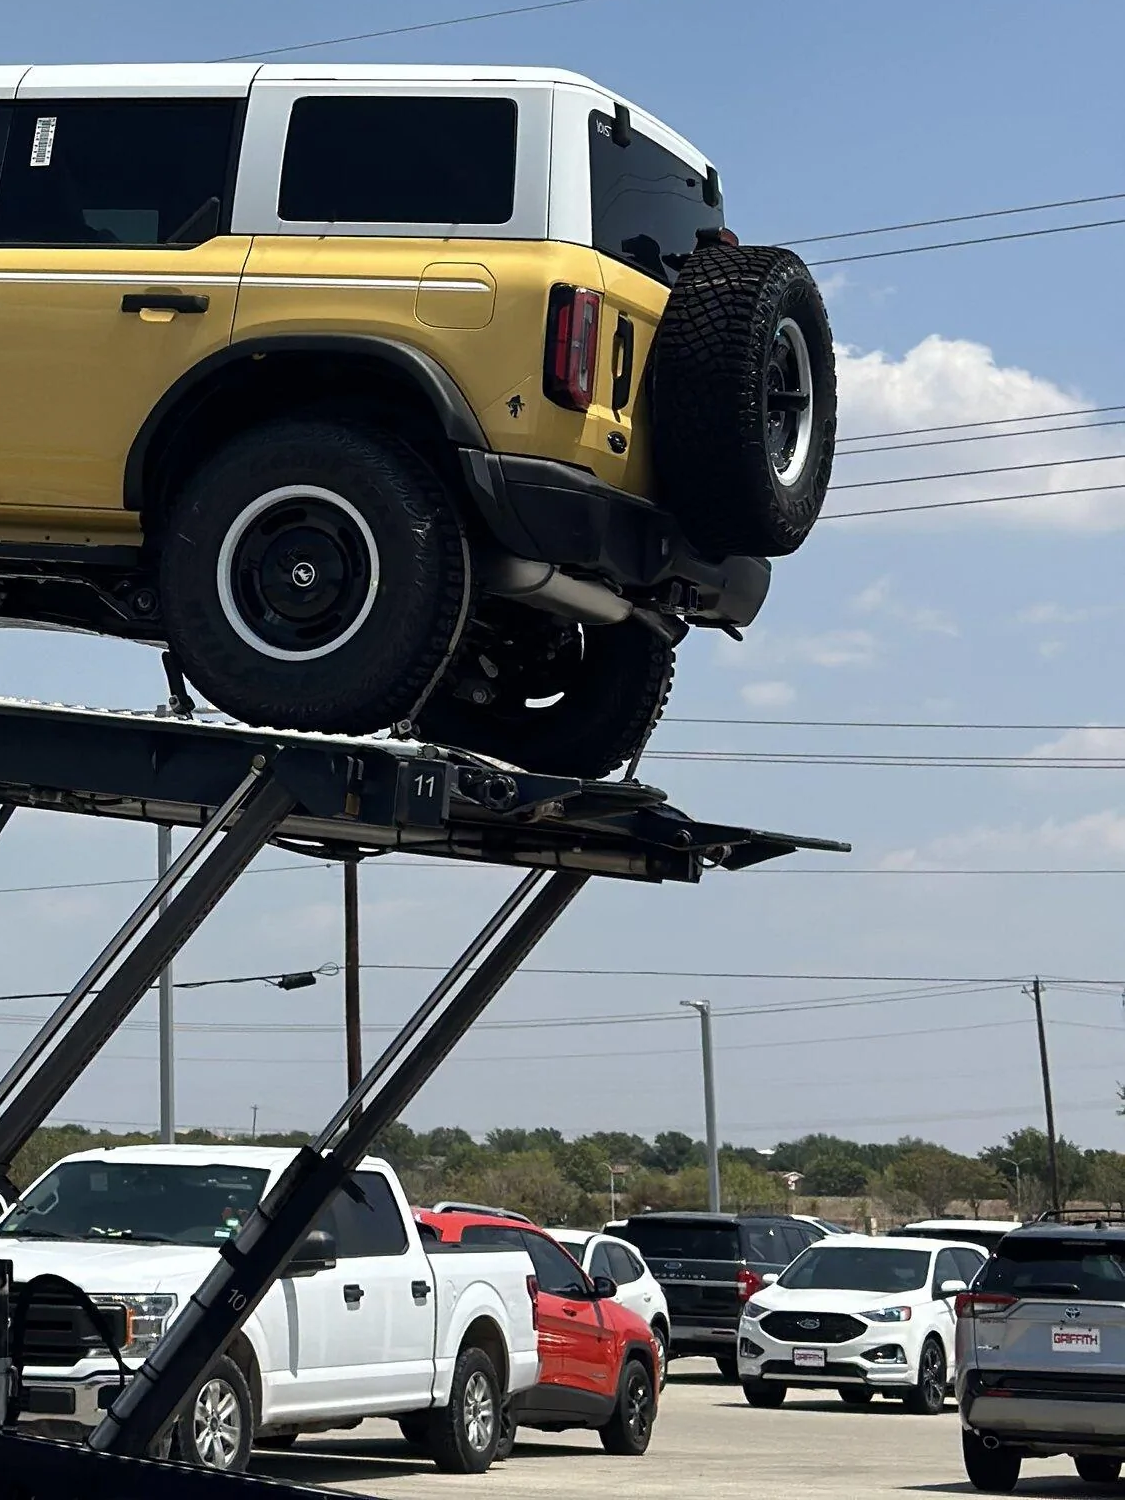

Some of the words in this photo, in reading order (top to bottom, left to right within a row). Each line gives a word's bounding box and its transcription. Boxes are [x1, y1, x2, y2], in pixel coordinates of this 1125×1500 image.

[414, 774, 435, 798] 11
[227, 1289, 247, 1311] 10
[1053, 1332, 1098, 1345] GRIFFITH
